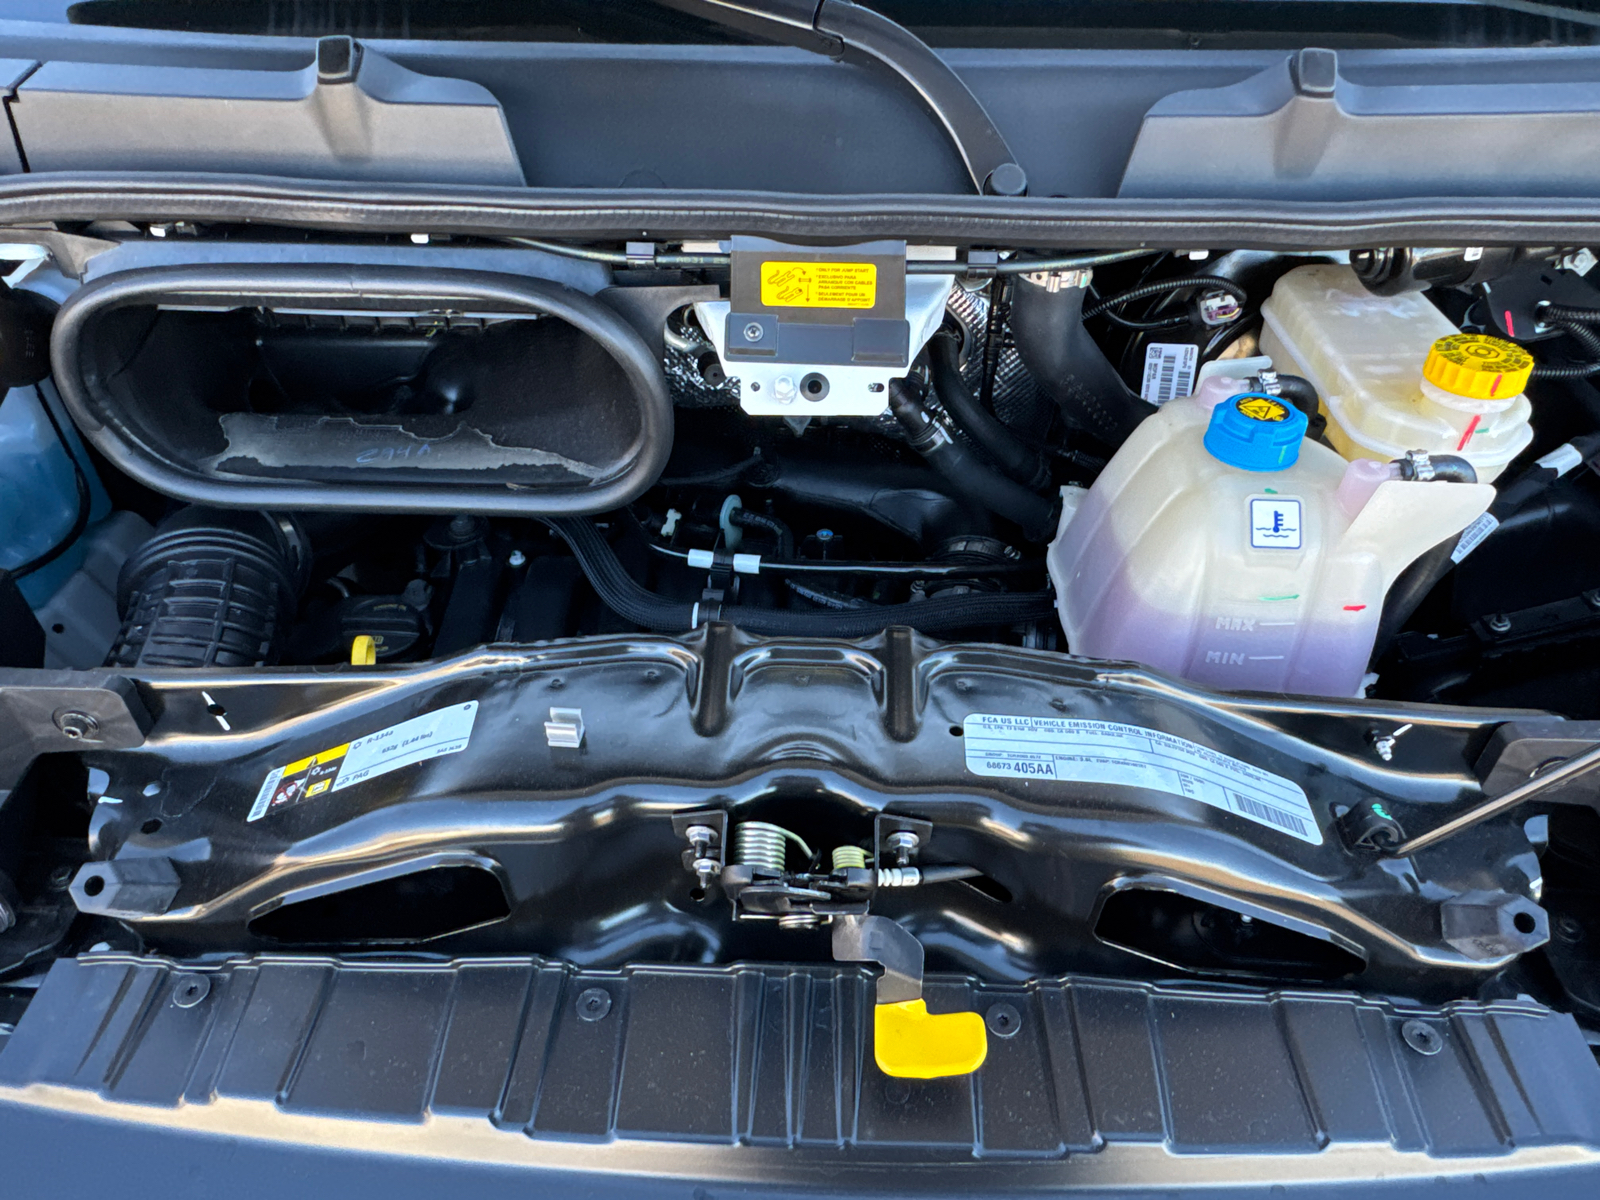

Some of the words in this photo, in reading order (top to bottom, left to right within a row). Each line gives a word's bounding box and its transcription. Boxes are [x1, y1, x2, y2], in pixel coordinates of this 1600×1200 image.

[1215, 616, 1256, 632] MAX
[1205, 650, 1245, 666] MIN
[1068, 721, 1105, 730] EMISSION
[1108, 724, 1142, 735] CONTROL
[1145, 731, 1194, 749] INFORMATION
[352, 770, 370, 781] PAG
[986, 761, 1011, 769] 68673
[1014, 762, 1054, 775] 405AA
